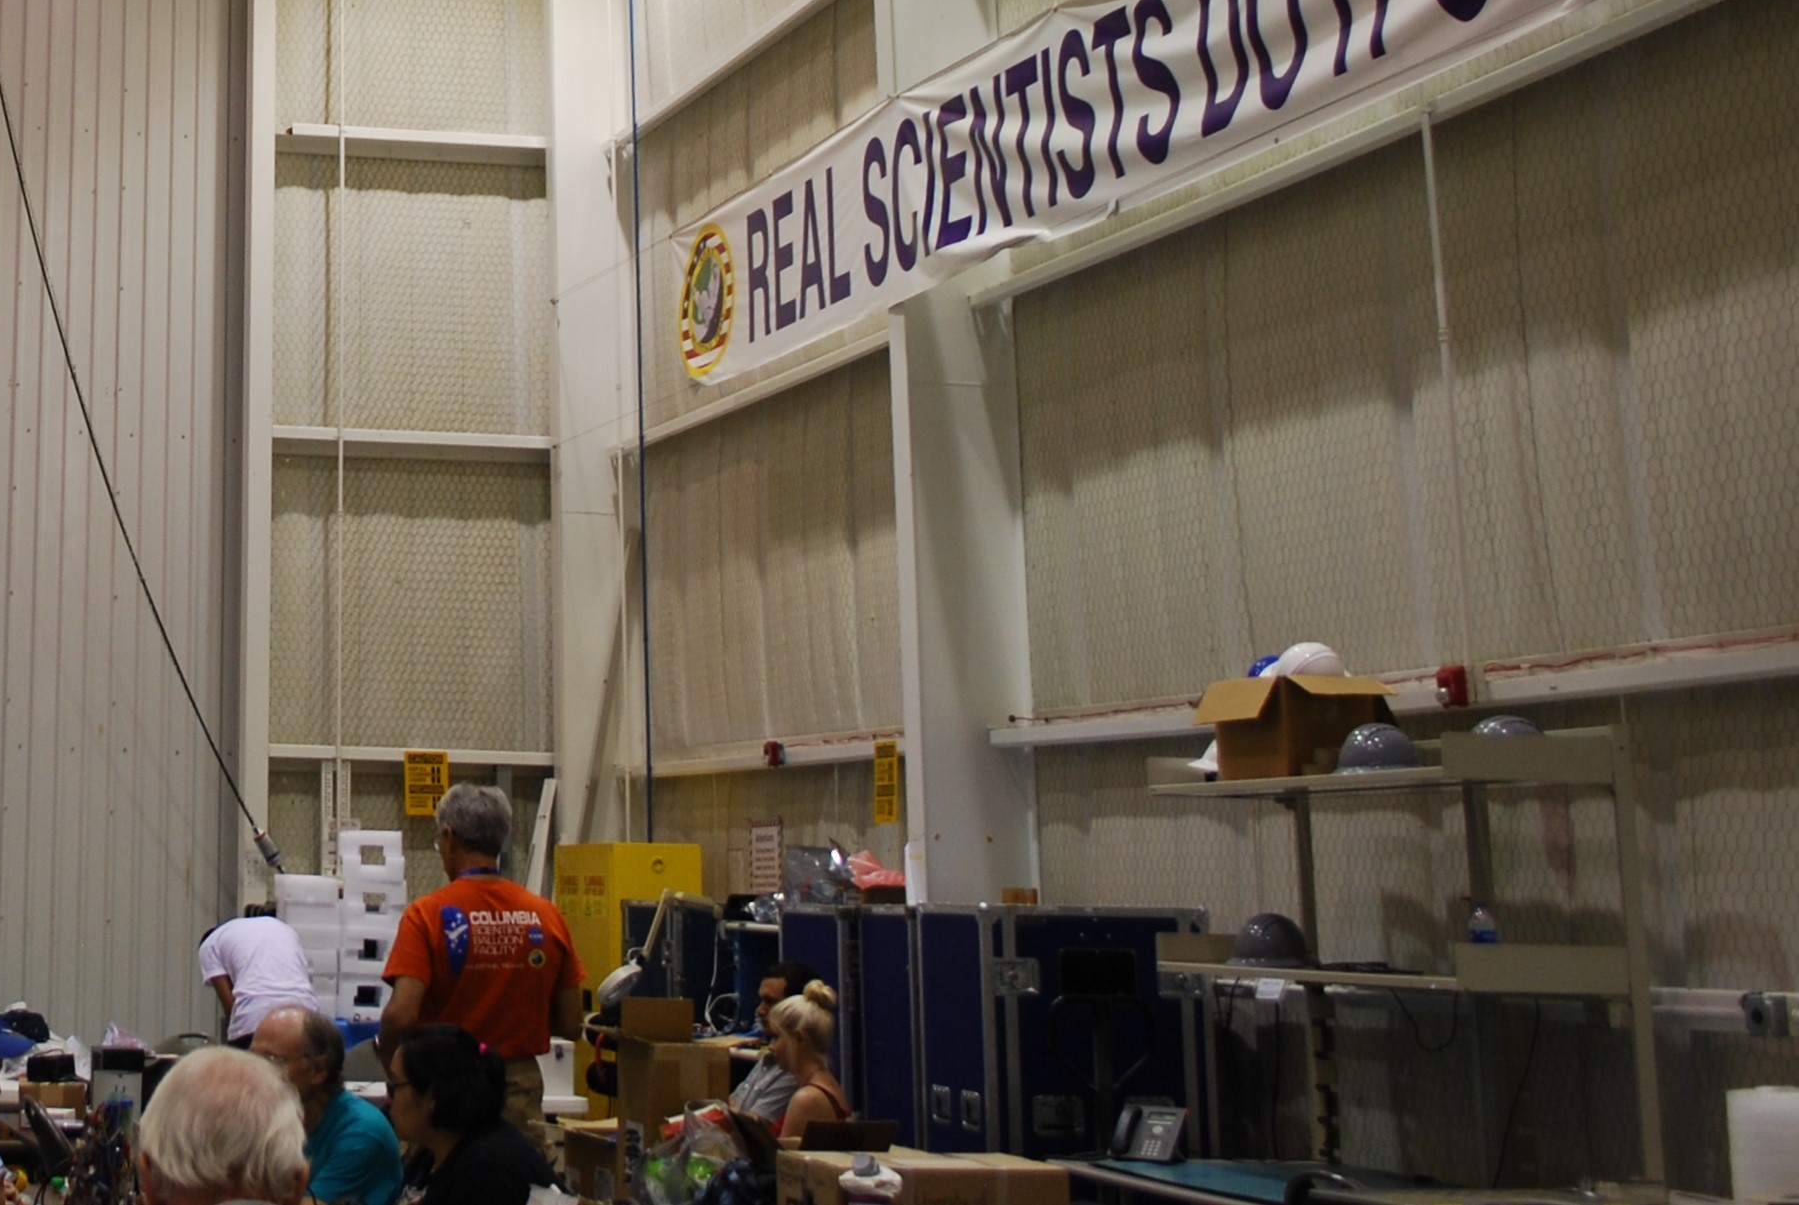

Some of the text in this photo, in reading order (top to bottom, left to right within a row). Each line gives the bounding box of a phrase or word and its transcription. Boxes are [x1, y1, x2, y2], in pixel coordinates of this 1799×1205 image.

[747, 167, 851, 343] REAL
[469, 911, 541, 925] COLUMBIA
[471, 925, 525, 935] SCIENTIFIC
[473, 935, 524, 945] BALLOON
[474, 945, 517, 955] FACILITY
